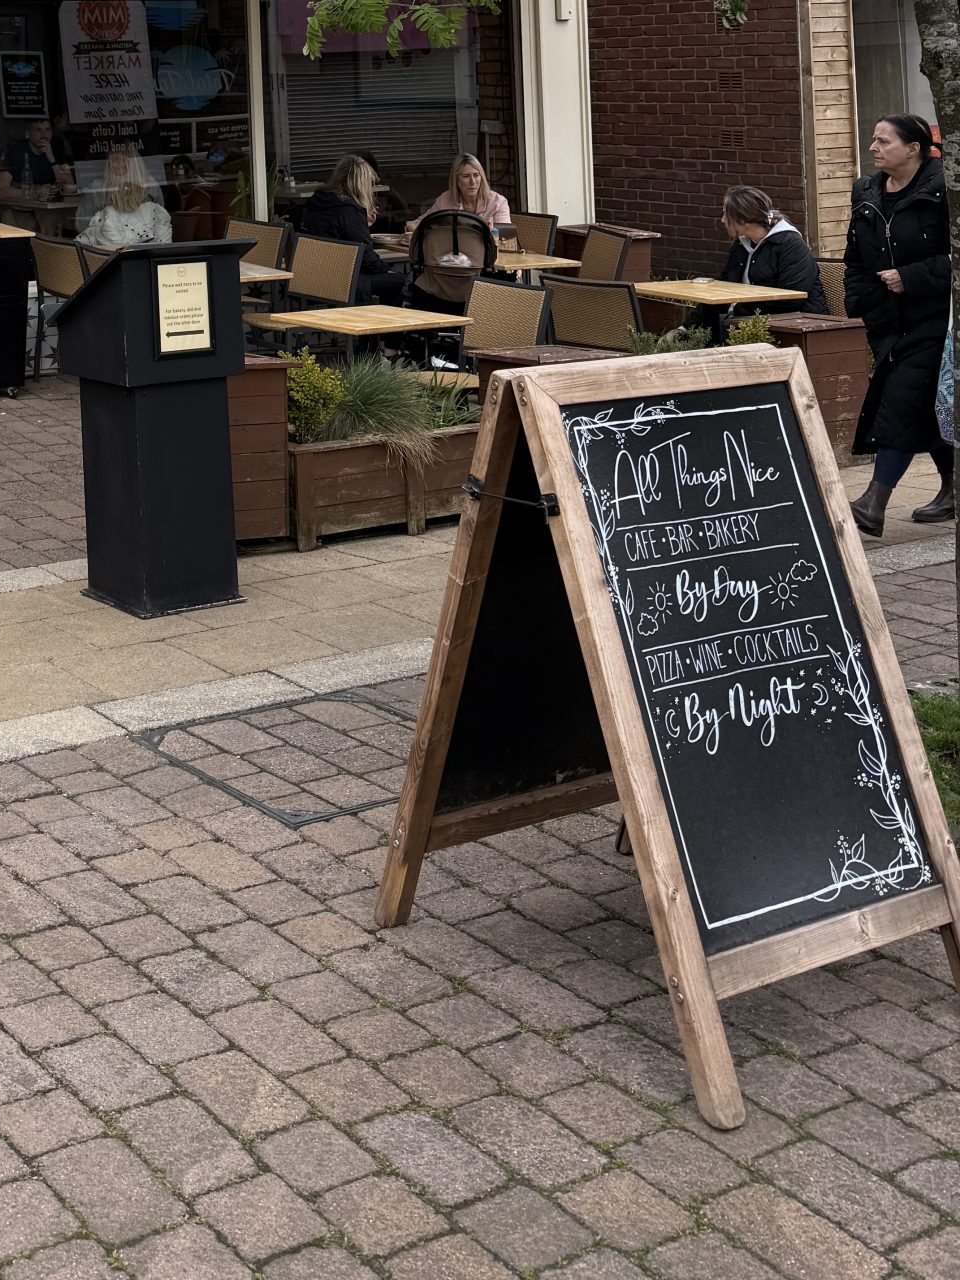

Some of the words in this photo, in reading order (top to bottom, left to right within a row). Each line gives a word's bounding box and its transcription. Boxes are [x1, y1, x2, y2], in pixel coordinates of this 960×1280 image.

[610, 450, 662, 519] All
[649, 432, 728, 509] Things
[723, 429, 780, 502] Nice
[624, 529, 662, 562] CAFE
[665, 524, 700, 556] BAR
[702, 513, 760, 550] BAKERY
[676, 569, 714, 622] By
[711, 566, 772, 622] Day
[645, 649, 685, 685] PIZZA
[688, 640, 728, 674] WINE
[733, 624, 819, 665] COCKTAILS
[684, 692, 729, 755] By
[727, 676, 806, 747] Night
